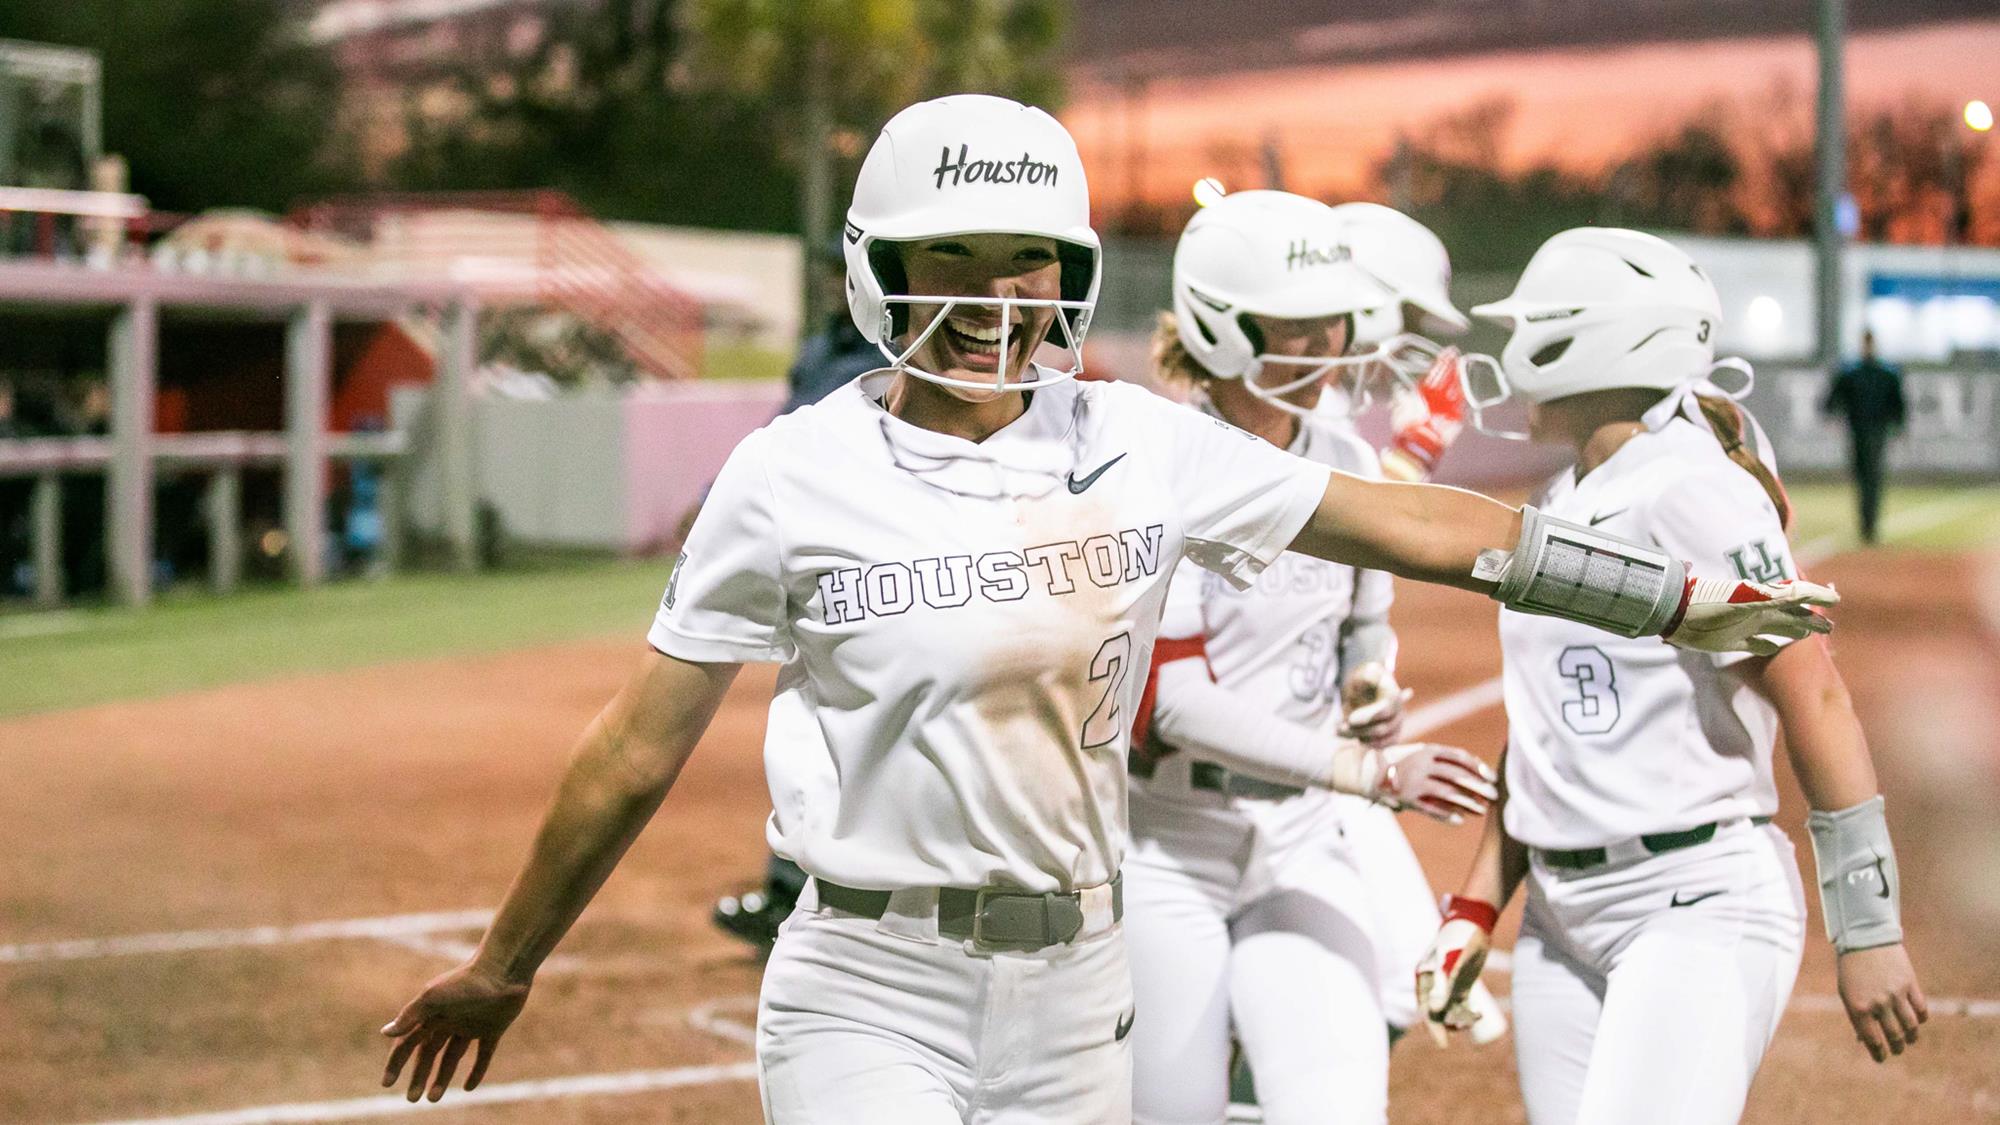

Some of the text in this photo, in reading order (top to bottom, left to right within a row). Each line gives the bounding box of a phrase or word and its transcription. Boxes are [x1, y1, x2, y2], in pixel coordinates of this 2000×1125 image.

[933, 143, 1058, 190] Houston
[1697, 319, 1711, 345] 3
[816, 523, 1164, 626] HOUSTON
[1080, 631, 1132, 750] 2
[1558, 644, 1621, 735] 3
[1847, 867, 1876, 886] 3
